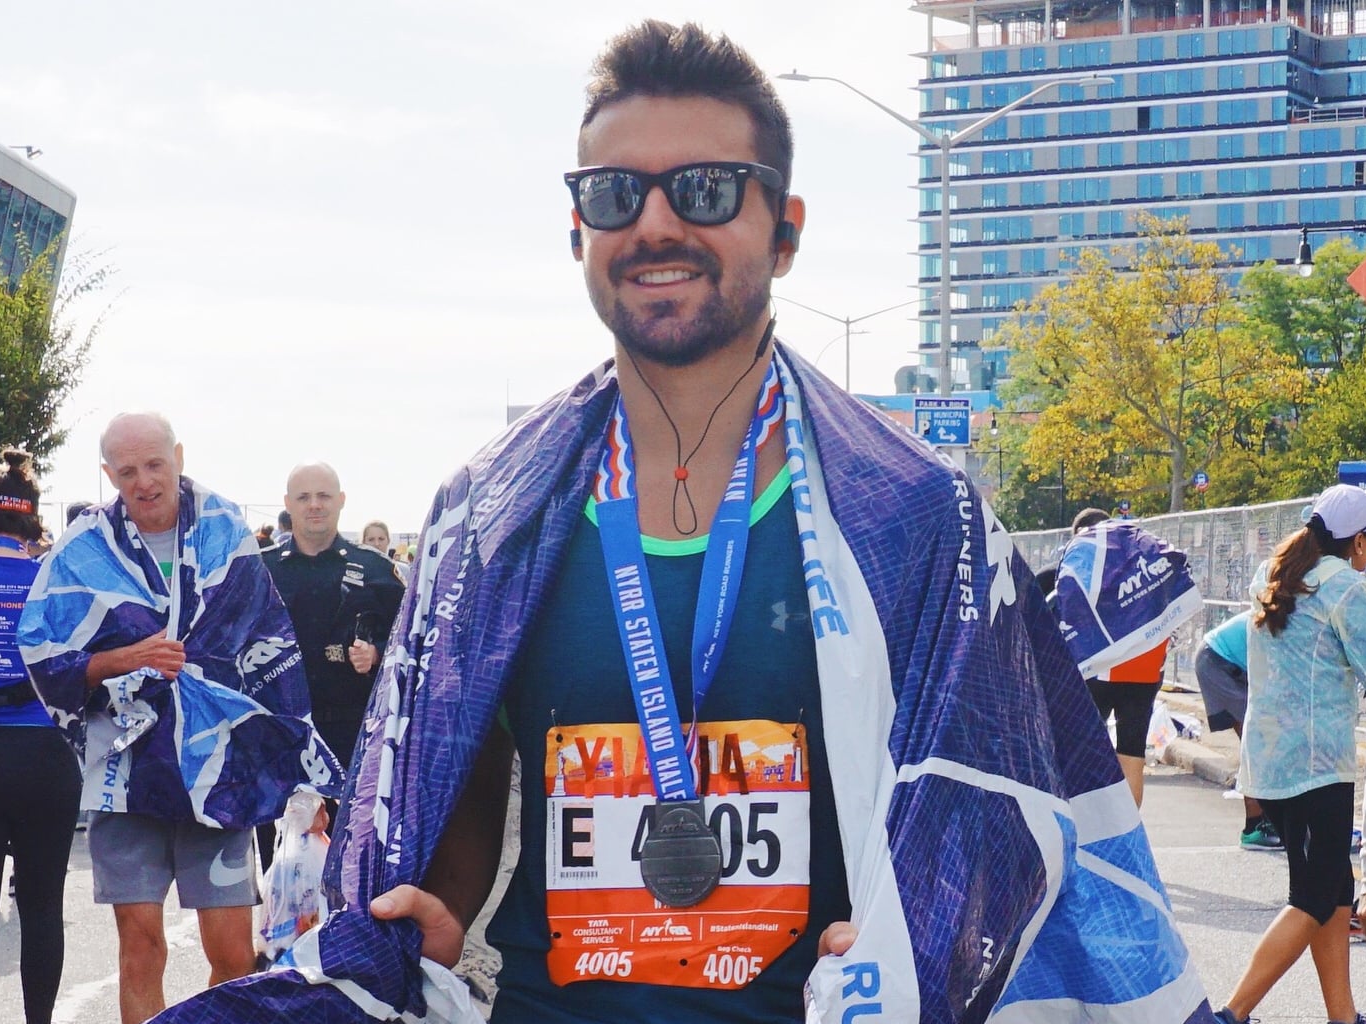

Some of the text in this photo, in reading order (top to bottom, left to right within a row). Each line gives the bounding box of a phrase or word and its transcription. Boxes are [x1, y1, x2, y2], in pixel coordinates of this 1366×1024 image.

[614, 564, 688, 801] NYRR STATEN ISLAND HALF
[562, 808, 594, 867] E
[631, 802, 782, 878] 405
[572, 926, 624, 936] CONSULTANCY
[587, 919, 609, 927] TATA
[709, 922, 778, 933] #StatenIslandHalf
[581, 936, 614, 944] SERVICES
[574, 951, 634, 977] 4005
[703, 954, 764, 986] 4005
